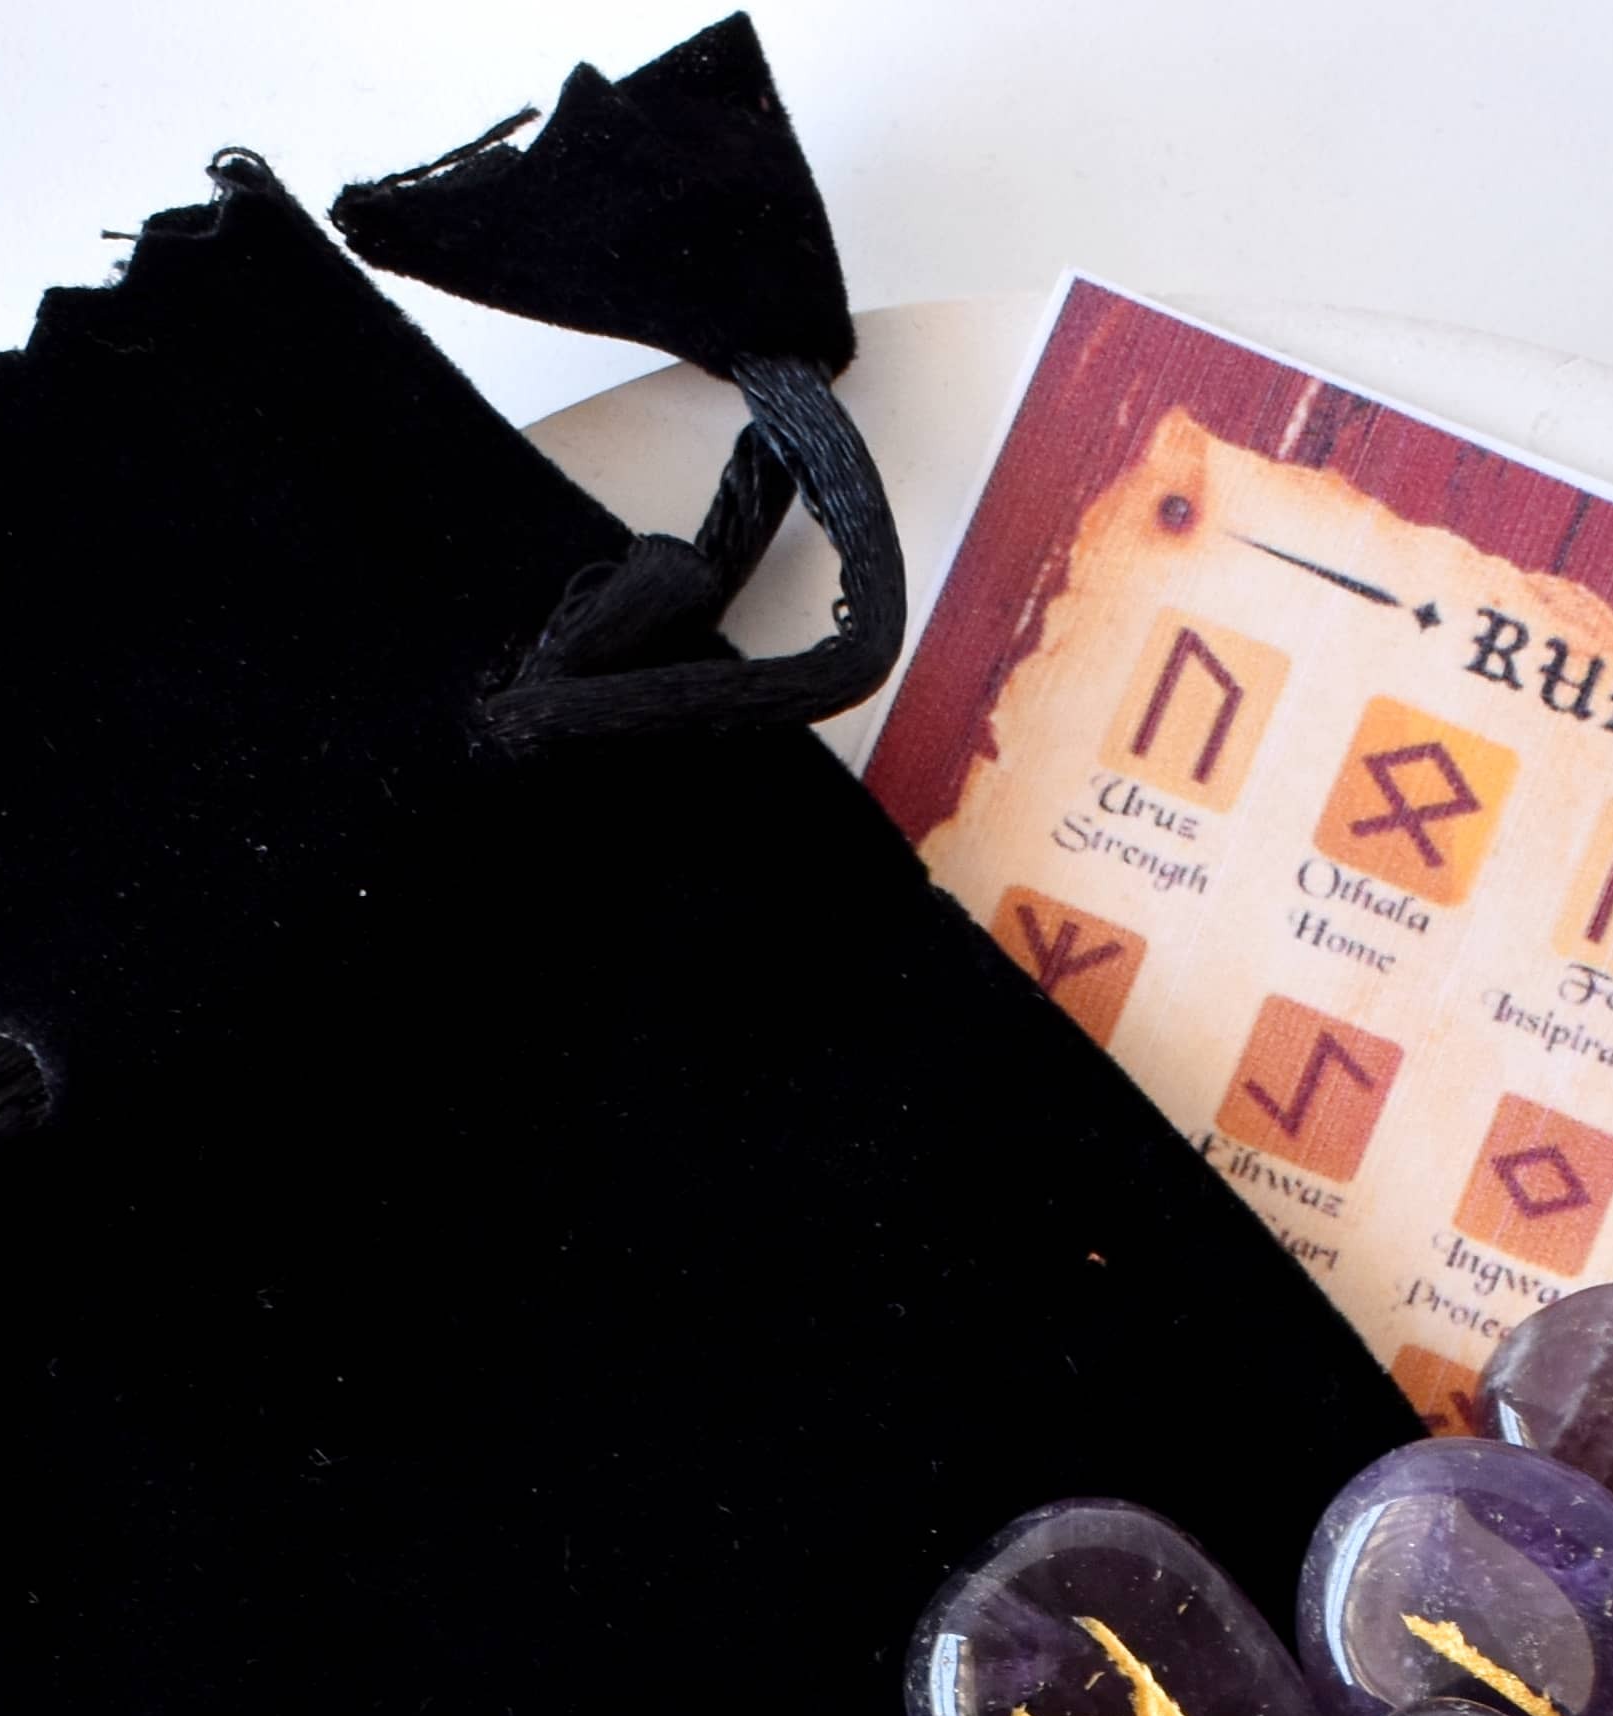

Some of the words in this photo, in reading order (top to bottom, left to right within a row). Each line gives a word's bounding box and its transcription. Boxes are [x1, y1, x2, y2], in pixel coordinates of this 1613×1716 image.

[1051, 814, 1210, 895] Strength
[1296, 855, 1431, 935] Othala
[1289, 908, 1397, 975] Home
[1432, 1229, 1561, 1306] Ingwa
